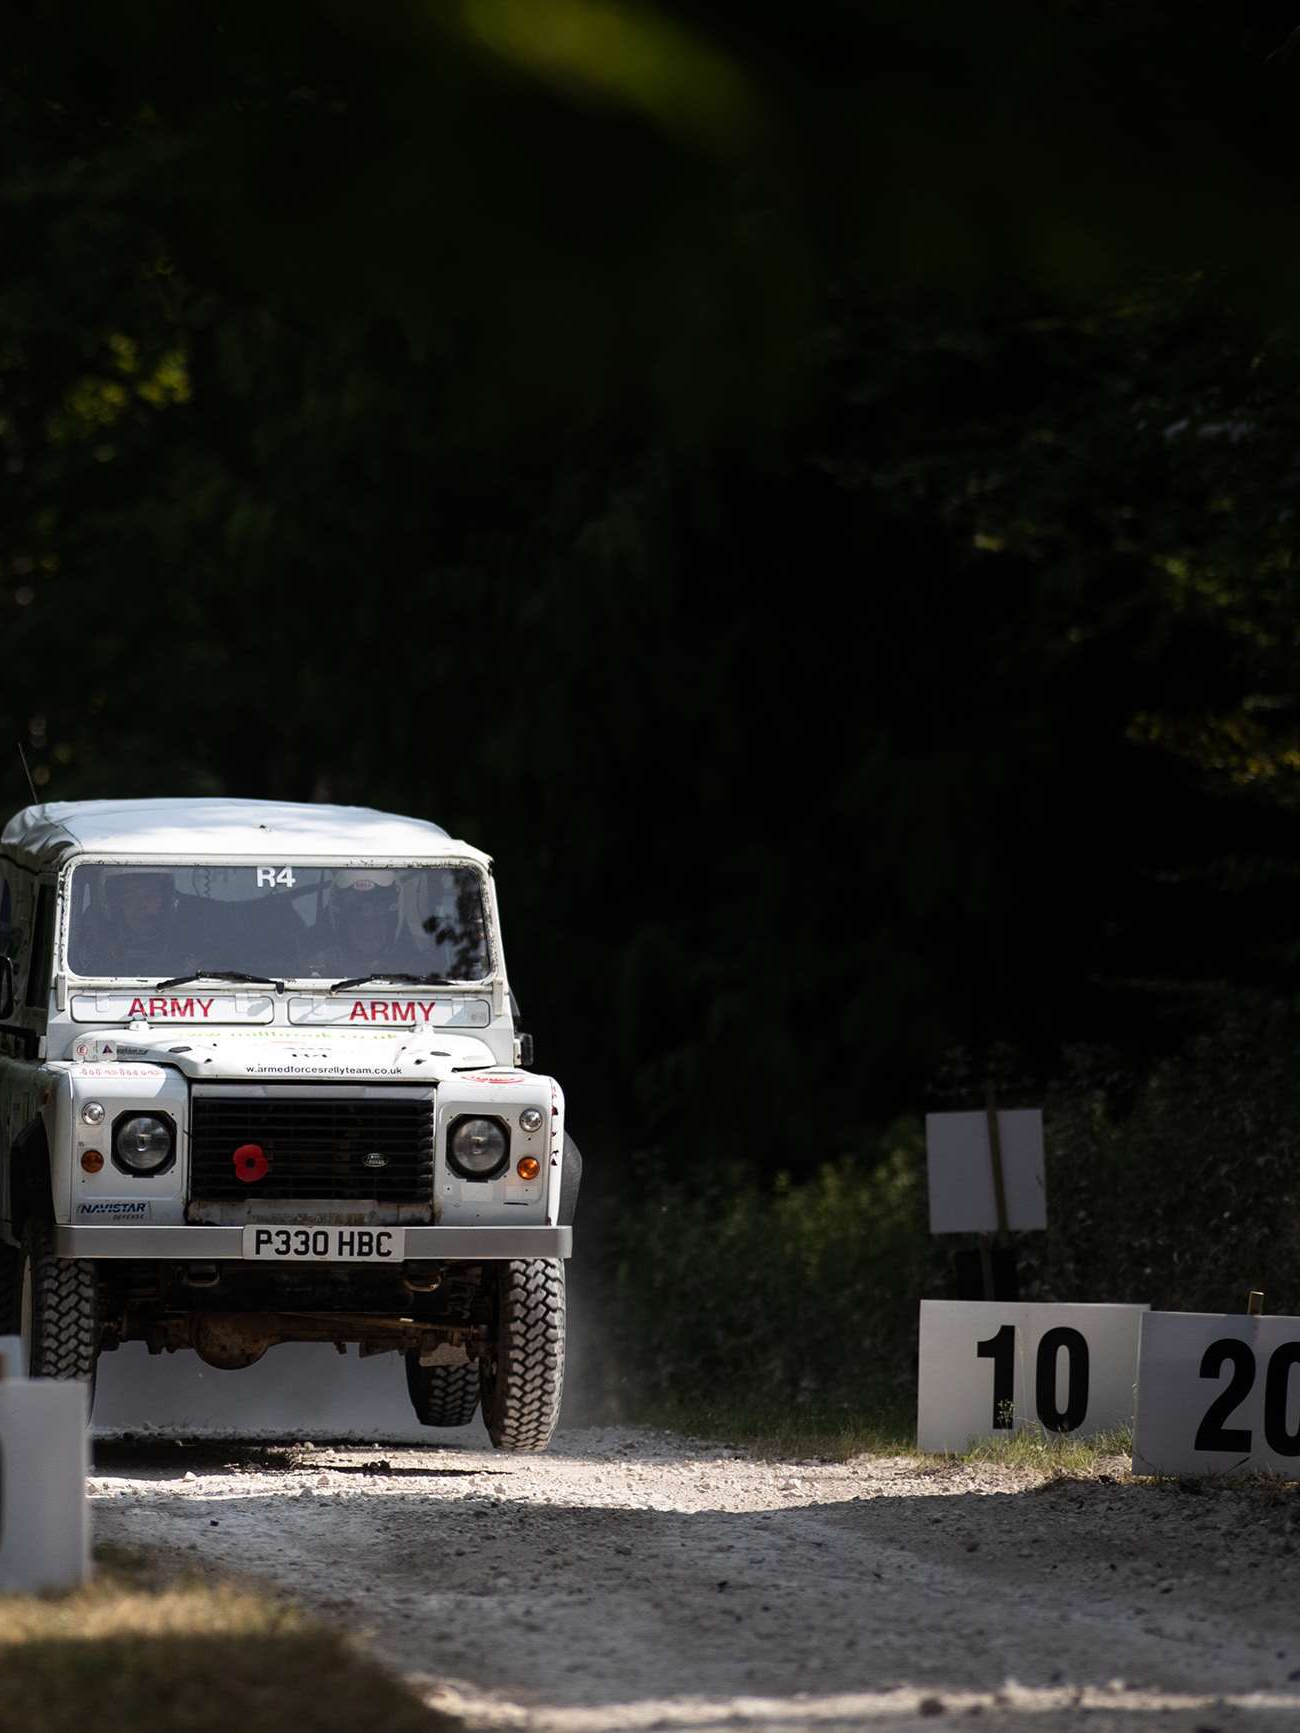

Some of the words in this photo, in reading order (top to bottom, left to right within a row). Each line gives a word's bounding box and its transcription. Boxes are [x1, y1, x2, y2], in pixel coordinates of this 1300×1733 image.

[256, 866, 296, 888] R4
[127, 997, 215, 1019] ARMY
[348, 1000, 437, 1022] ARMY
[80, 1202, 147, 1215] NAVISTAR
[255, 1229, 329, 1256] P330
[338, 1231, 393, 1257] HBC
[976, 1324, 1090, 1433] 10
[1194, 1337, 1300, 1457] 20
